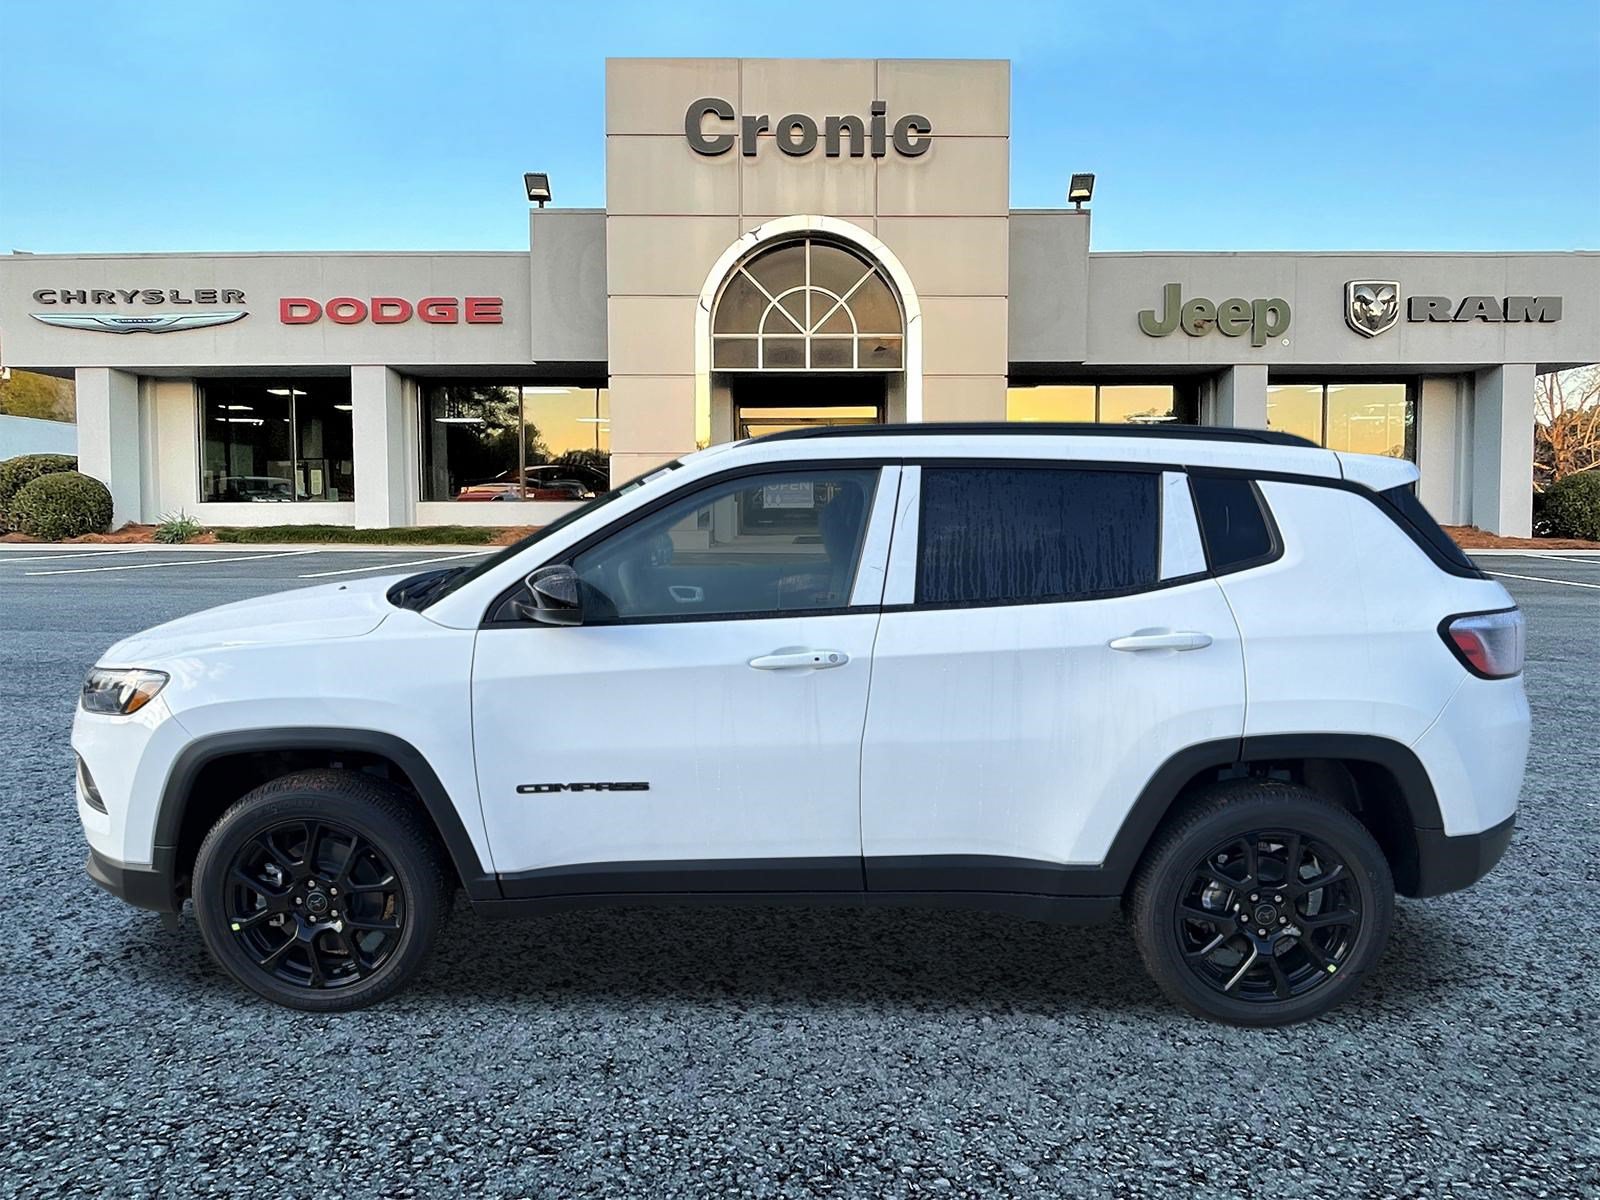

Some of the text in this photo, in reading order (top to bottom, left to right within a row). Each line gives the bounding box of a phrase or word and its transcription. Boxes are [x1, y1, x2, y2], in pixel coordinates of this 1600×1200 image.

[684, 97, 933, 158] Cronic
[32, 288, 247, 305] CHRYSLER
[280, 296, 504, 325] DODGE
[1407, 295, 1563, 323] RAM
[1138, 283, 1291, 347] Jeep
[516, 782, 650, 793] COMPASS
